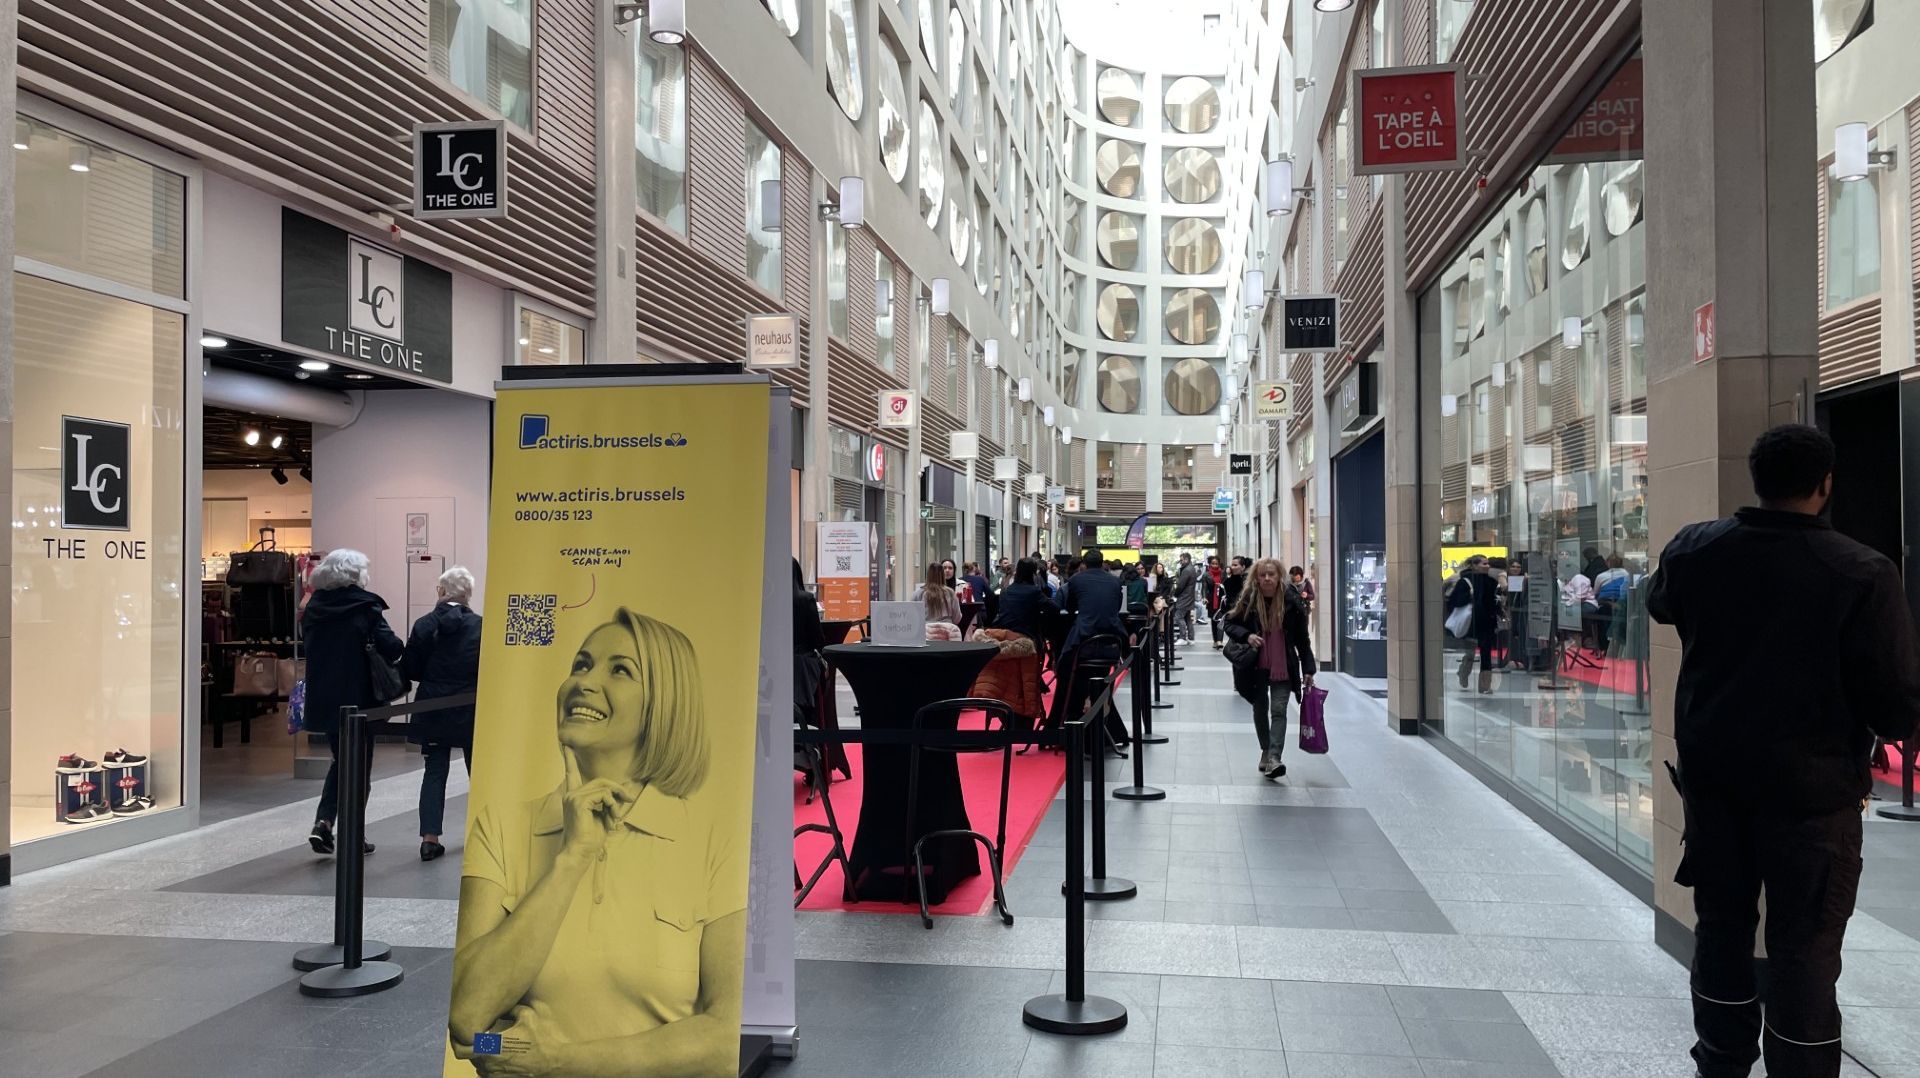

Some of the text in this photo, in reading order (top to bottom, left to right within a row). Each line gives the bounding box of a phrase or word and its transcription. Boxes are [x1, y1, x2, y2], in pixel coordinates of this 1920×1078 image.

[1373, 106, 1443, 130] TAPE À
[1379, 130, 1444, 150] L'OEIL
[426, 193, 494, 207] THE ONE
[1289, 316, 1331, 327] VENIZI
[754, 331, 793, 346] neuhaus
[325, 326, 423, 373] THE ONE
[892, 400, 904, 412] di
[538, 433, 663, 449] actiris.brussels
[516, 486, 686, 503] www.actiris.brussels
[514, 509, 593, 522] 0800/35 123
[42, 538, 146, 560] THE ONE
[559, 547, 631, 556] SCANNEZ-MOI
[571, 557, 623, 568] SCAN MIJ
